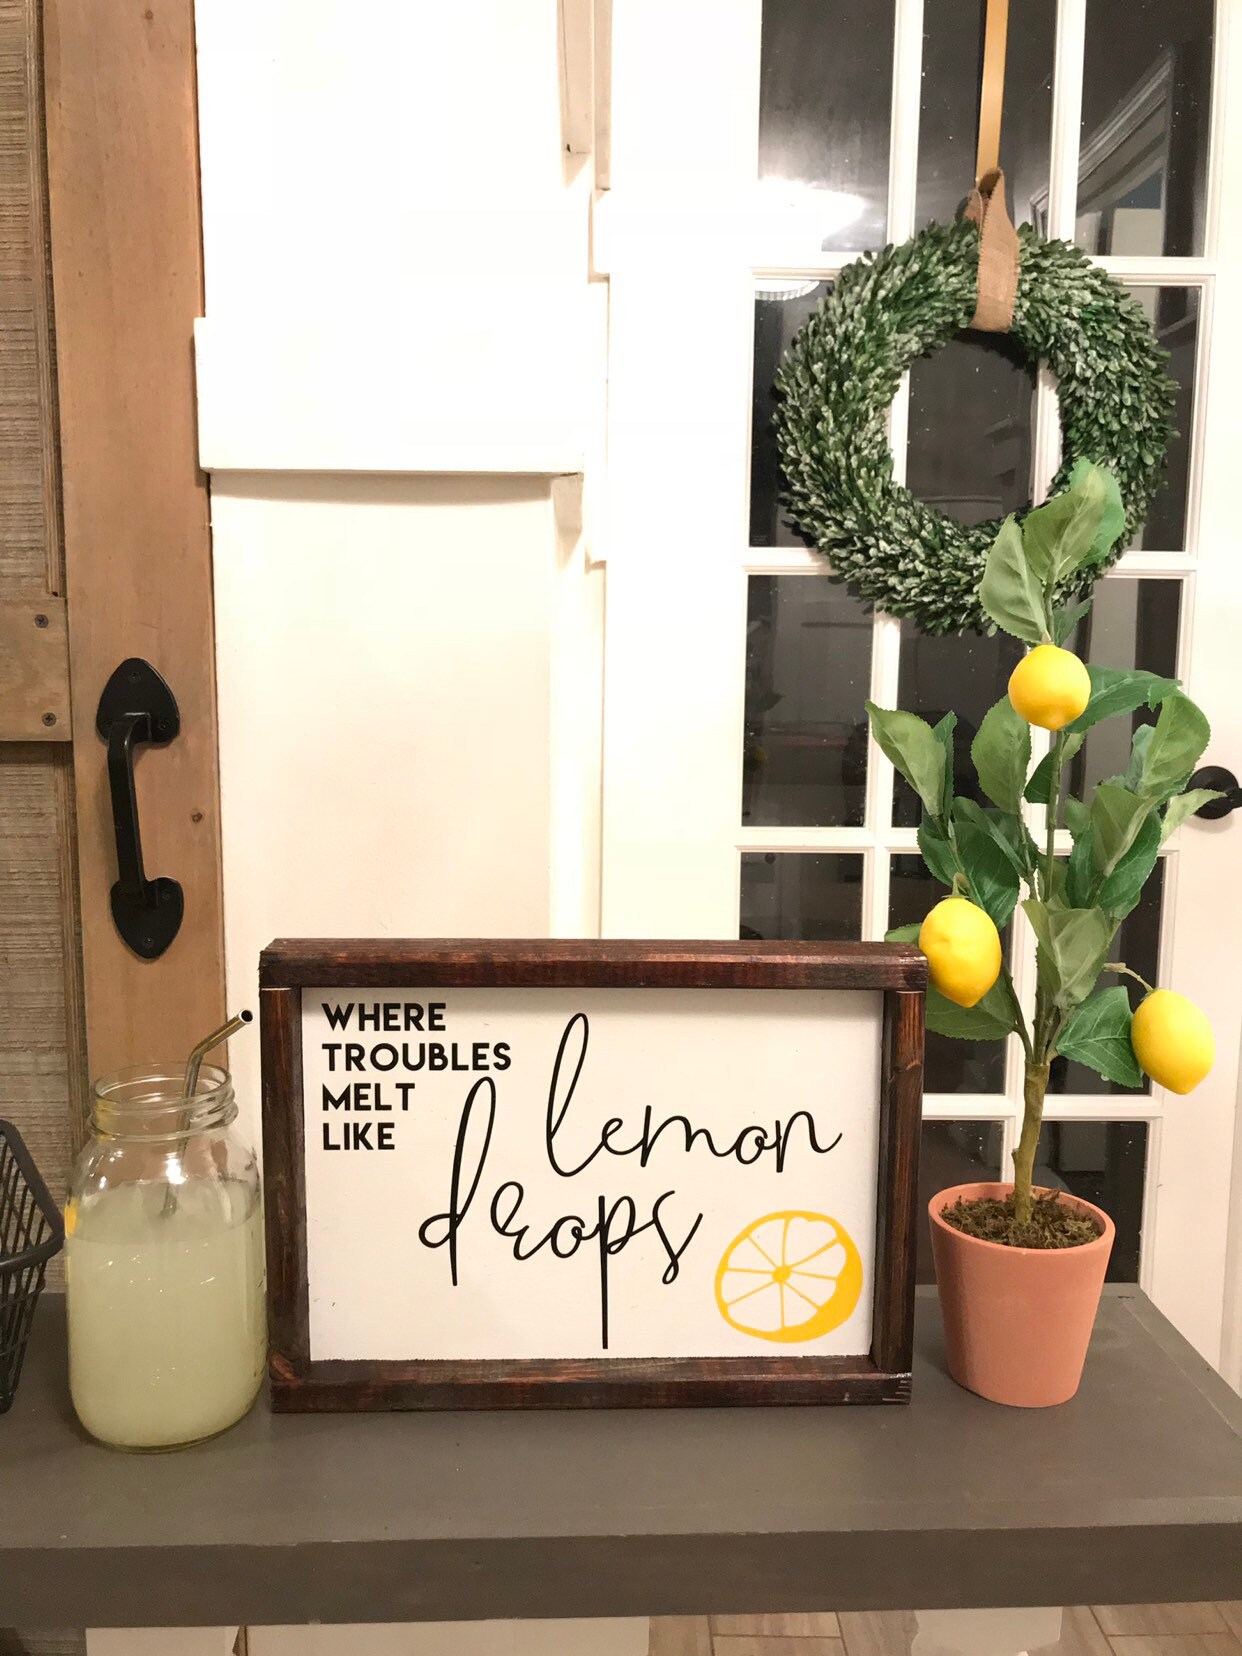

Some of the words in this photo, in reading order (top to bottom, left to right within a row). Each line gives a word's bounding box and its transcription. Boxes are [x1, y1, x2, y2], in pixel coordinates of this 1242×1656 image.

[320, 1002, 447, 1032] WHERE
[320, 1042, 513, 1072] TROUBLES
[322, 1082, 416, 1112] MELT
[545, 1012, 843, 1178] lemon
[322, 1122, 396, 1151] LIKE
[418, 1076, 704, 1350] drops
